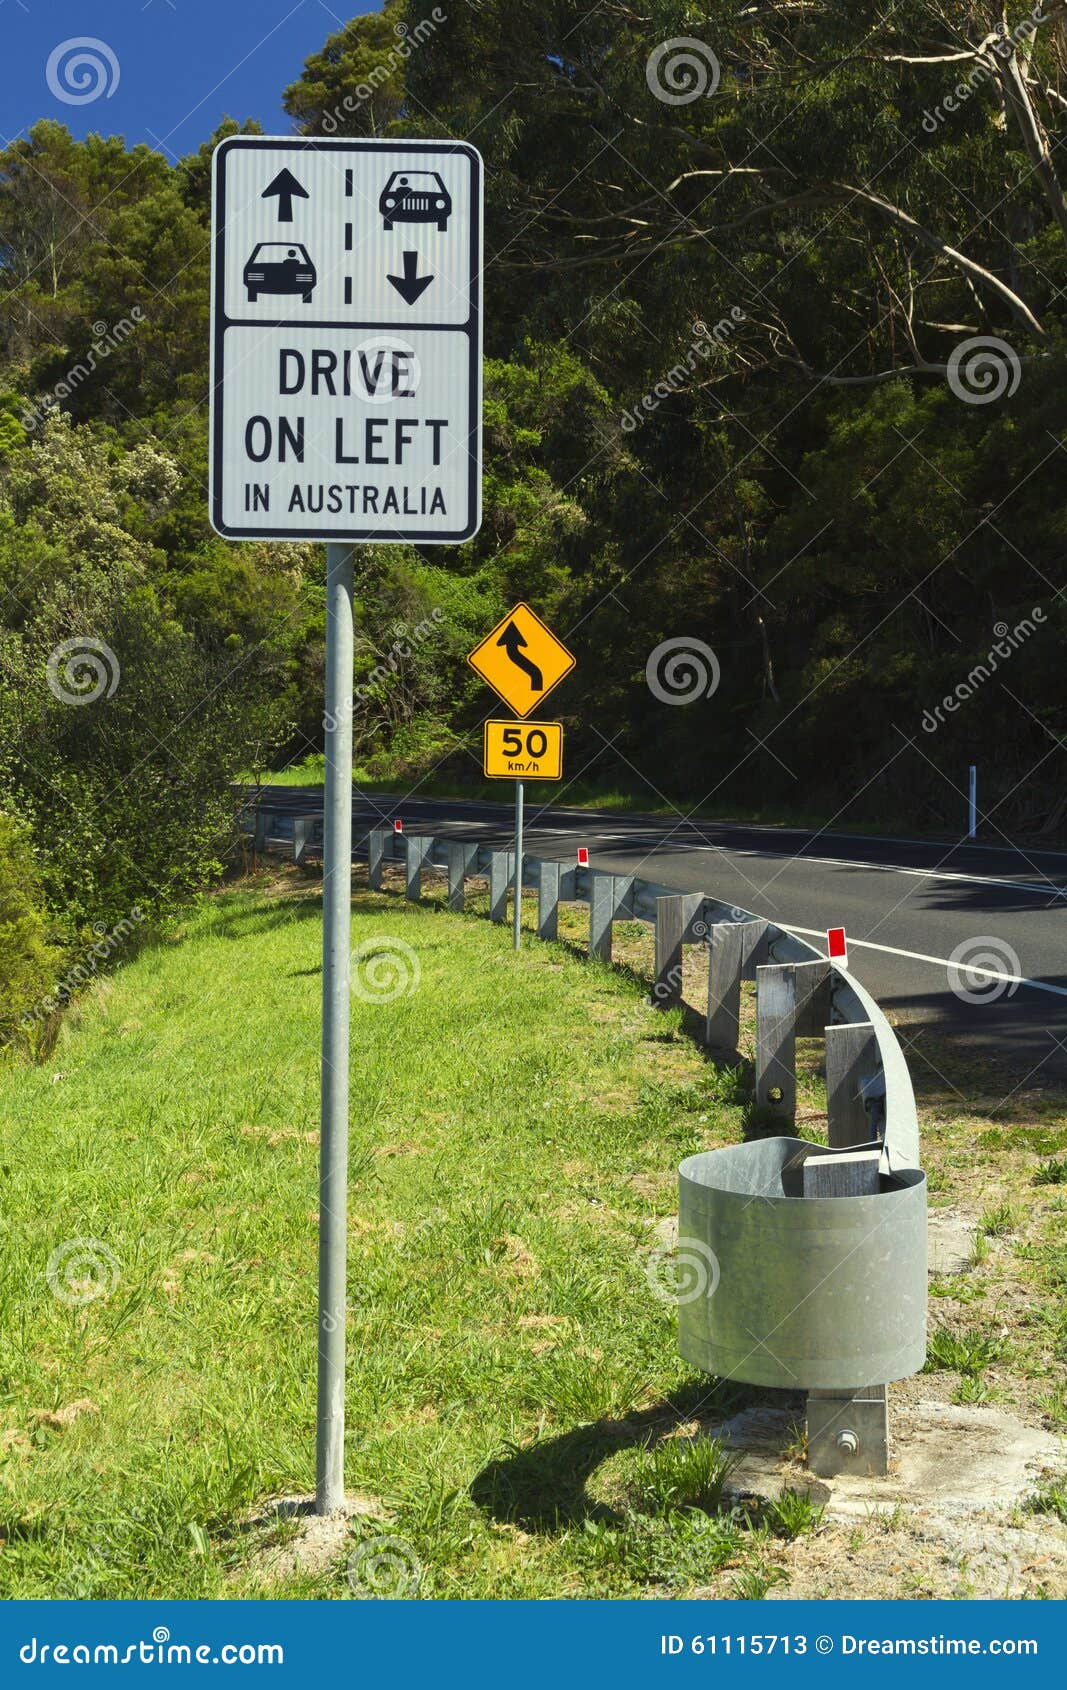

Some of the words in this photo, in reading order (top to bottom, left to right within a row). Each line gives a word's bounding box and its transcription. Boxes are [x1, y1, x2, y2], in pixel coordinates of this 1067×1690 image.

[279, 348, 416, 398] DRIVE
[244, 415, 305, 463] ON
[335, 417, 449, 466] LEFT
[244, 483, 270, 513] IN
[287, 484, 448, 516] AUSTRALIA
[502, 728, 548, 759] 50
[507, 760, 540, 772] km/h
